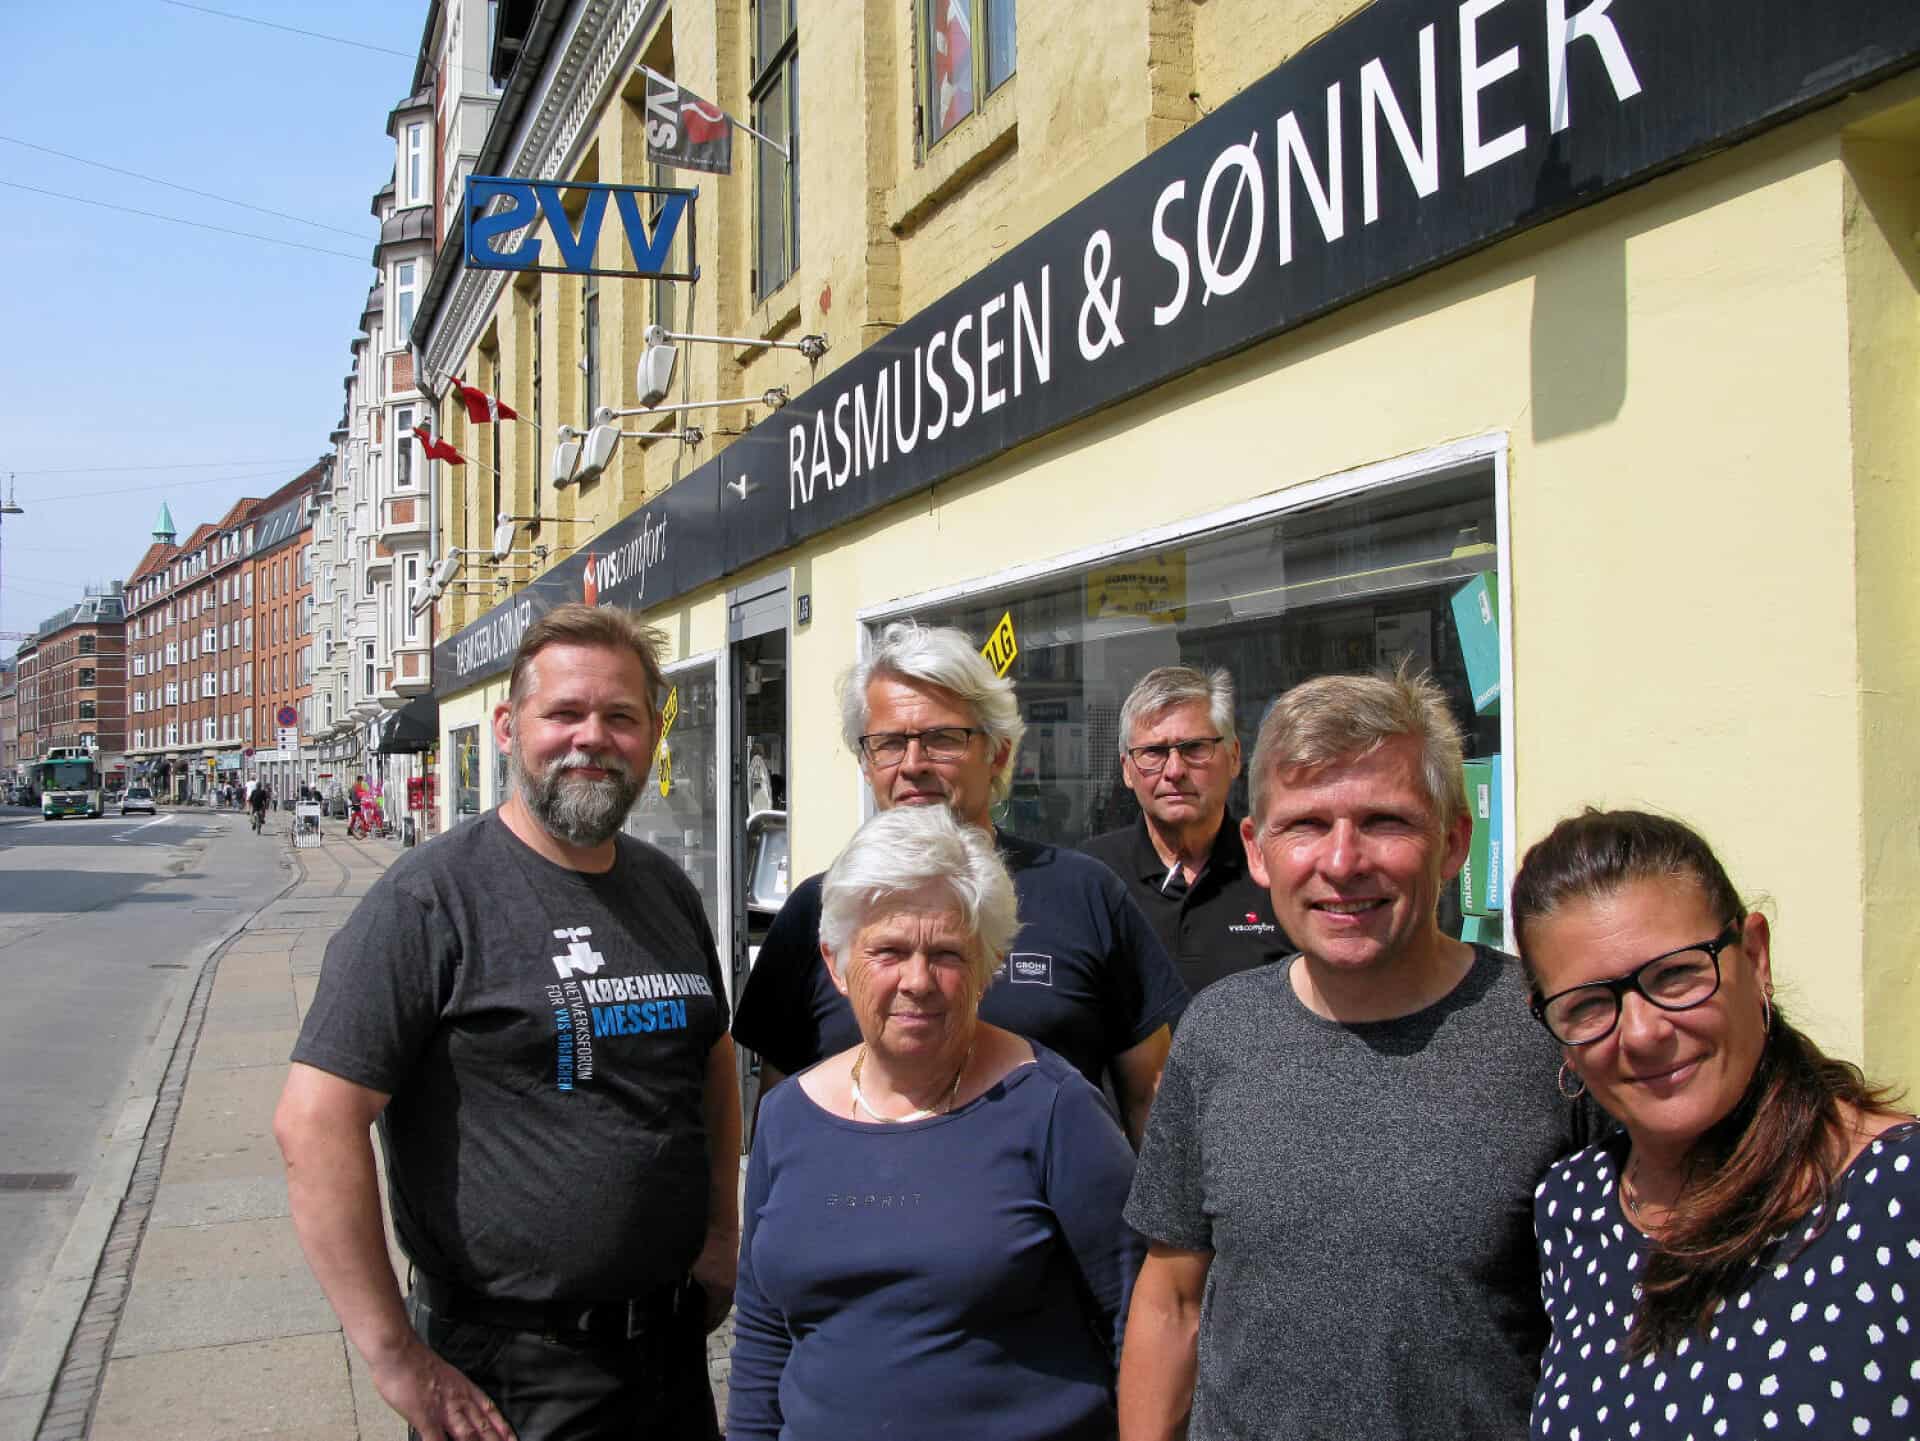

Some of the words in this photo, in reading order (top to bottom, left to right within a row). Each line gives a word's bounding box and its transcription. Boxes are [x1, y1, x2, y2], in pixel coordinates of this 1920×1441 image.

[789, 264, 1051, 511] RASMUSSEN
[1077, 228, 1125, 362] &
[1151, 0, 1643, 327] SØNNER
[544, 983, 562, 1006] FOR
[582, 973, 712, 1004] KØBENHAVNE
[564, 980, 594, 1081] NETVÆRKSFORUM
[592, 1000, 687, 1037] MESSEN
